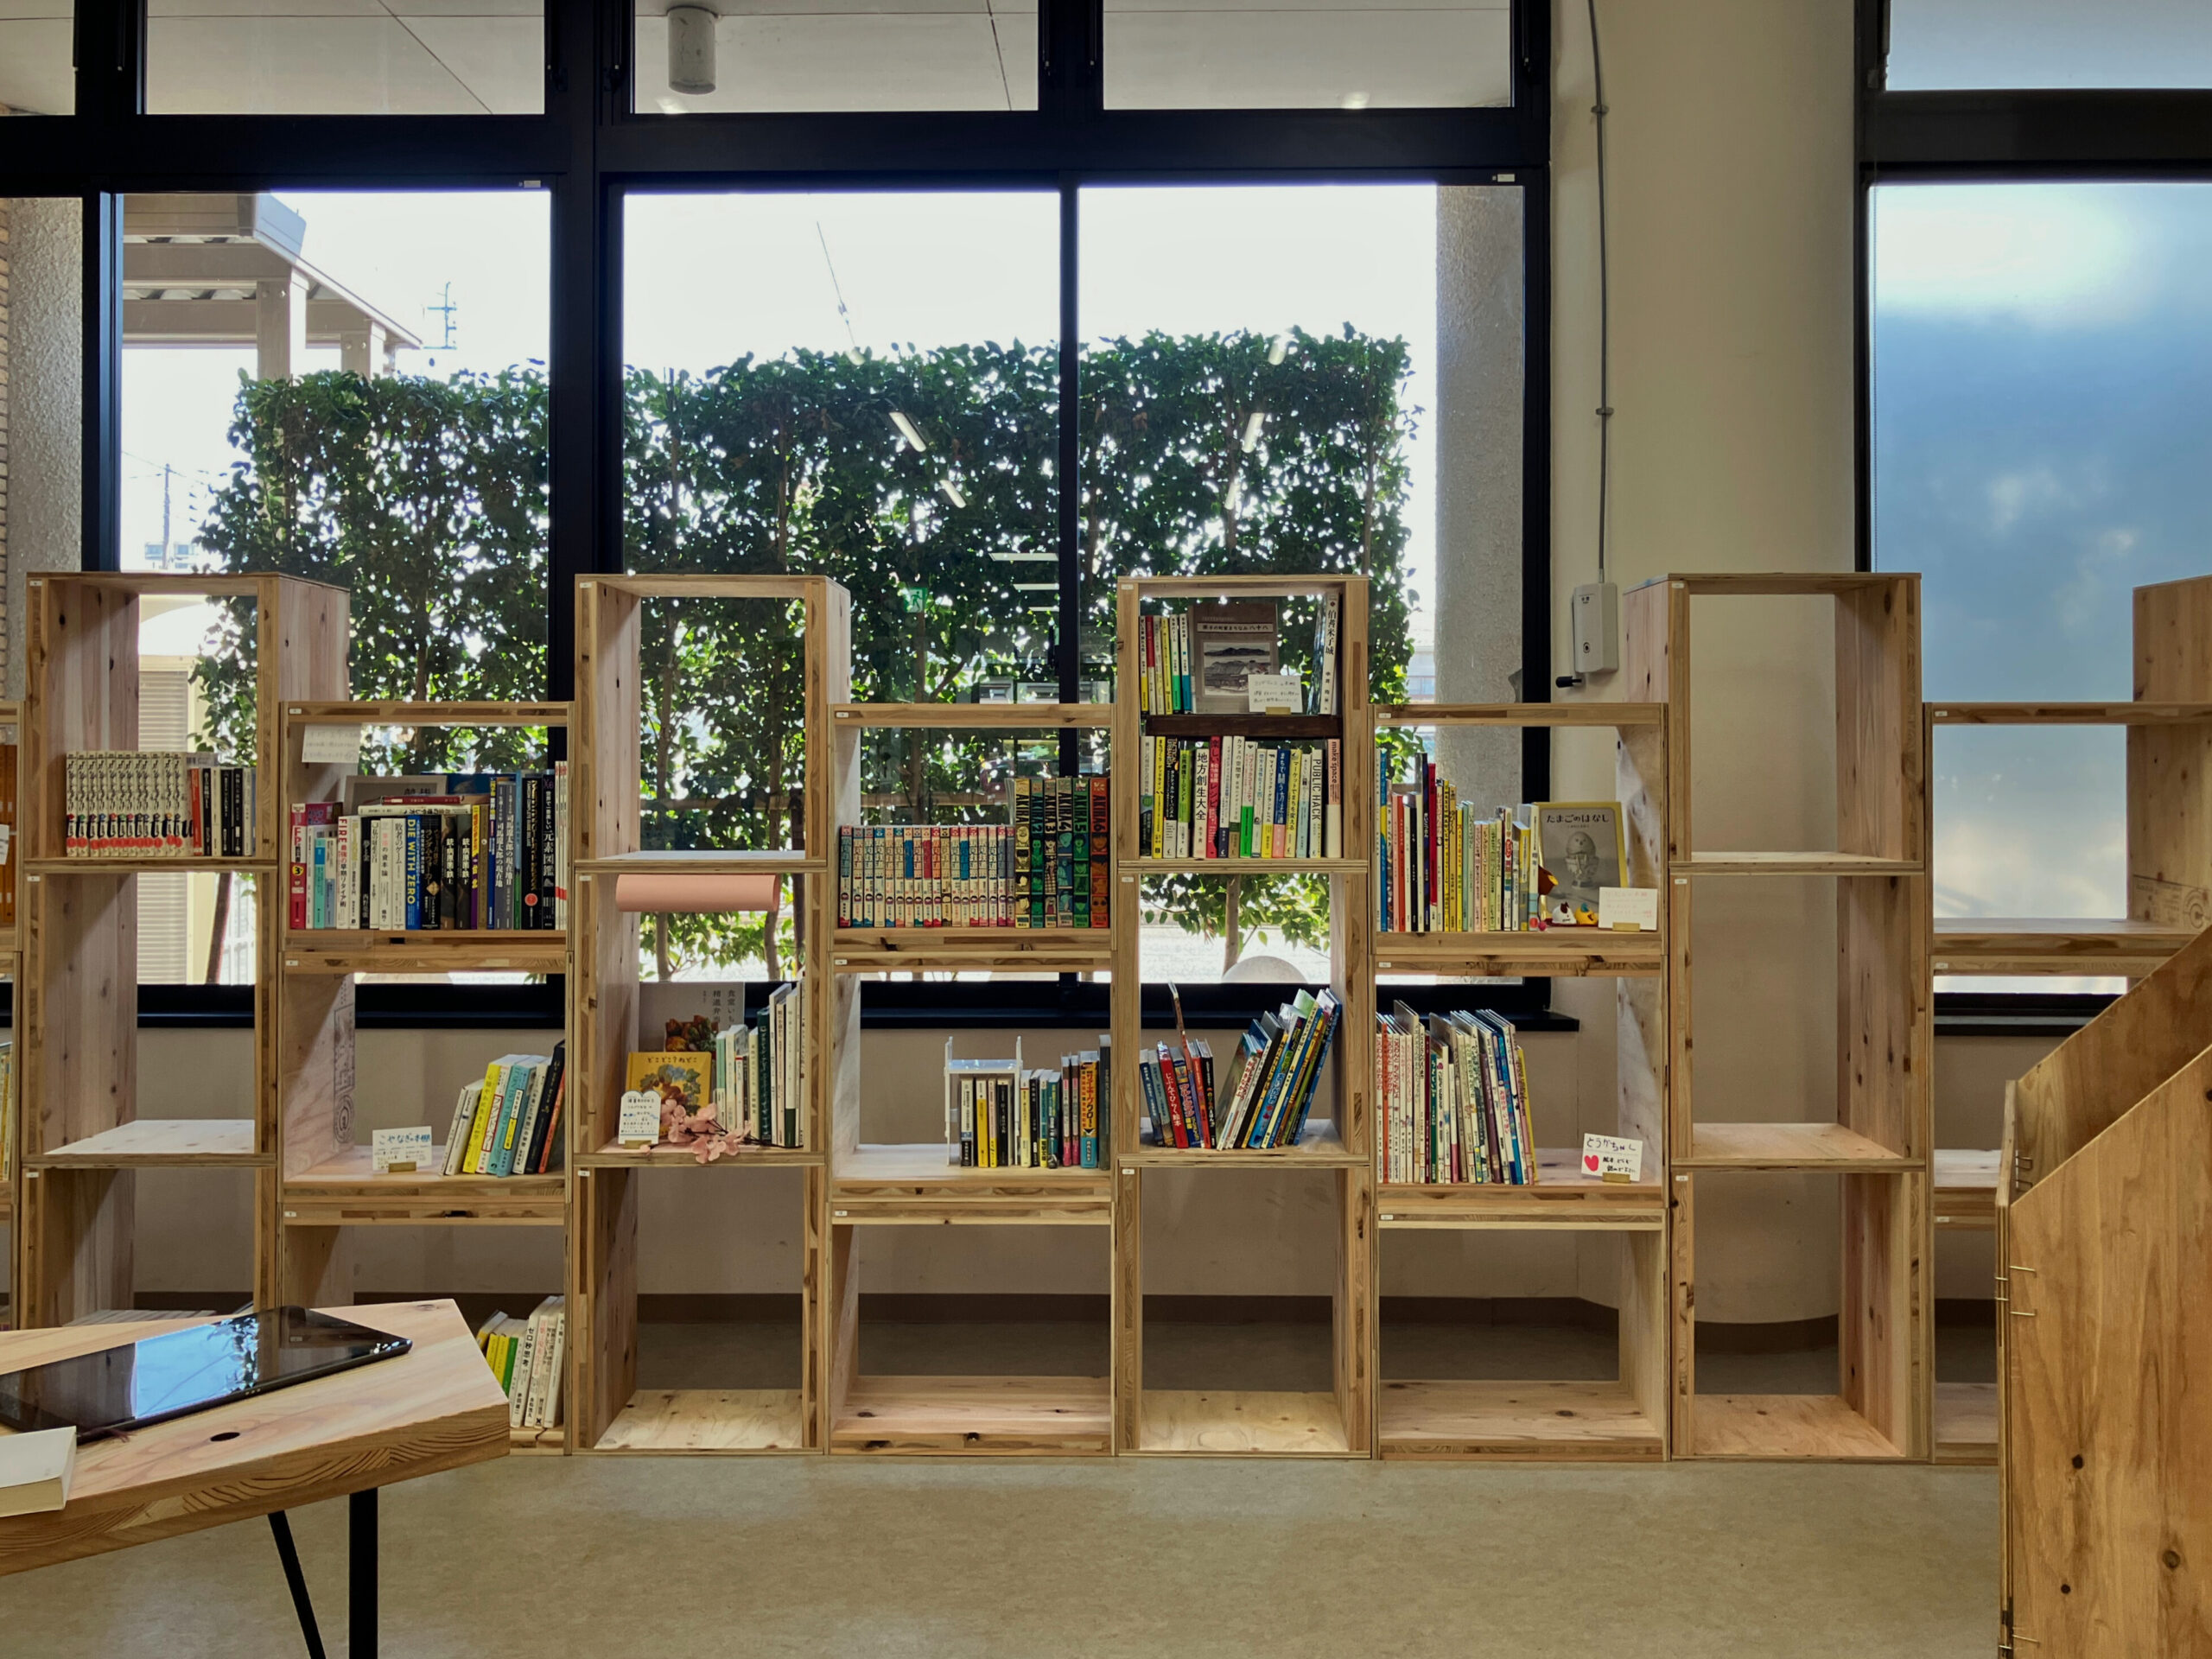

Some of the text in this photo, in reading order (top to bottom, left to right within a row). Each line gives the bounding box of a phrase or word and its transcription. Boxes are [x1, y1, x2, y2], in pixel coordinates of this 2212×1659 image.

[1325, 609, 1337, 656] 伯耆米子城
[1196, 753, 1208, 821] 地方創生大全
[1312, 759, 1322, 821] PUBLIC HACK
[1015, 793, 1030, 823] AKIRA
[1032, 794, 1044, 823] AKIRA
[1045, 794, 1056, 823] AKIRA
[1058, 792, 1072, 821] AKIRA
[1074, 794, 1088, 823] AKIRA
[1093, 794, 1106, 823] AKIRA
[1546, 814, 1610, 823] たまごのはなし
[395, 823, 404, 864] 敗者のゲーム
[407, 819, 416, 905] DIE WITH ZERO
[522, 1328, 534, 1367] ゼロ秒思考
